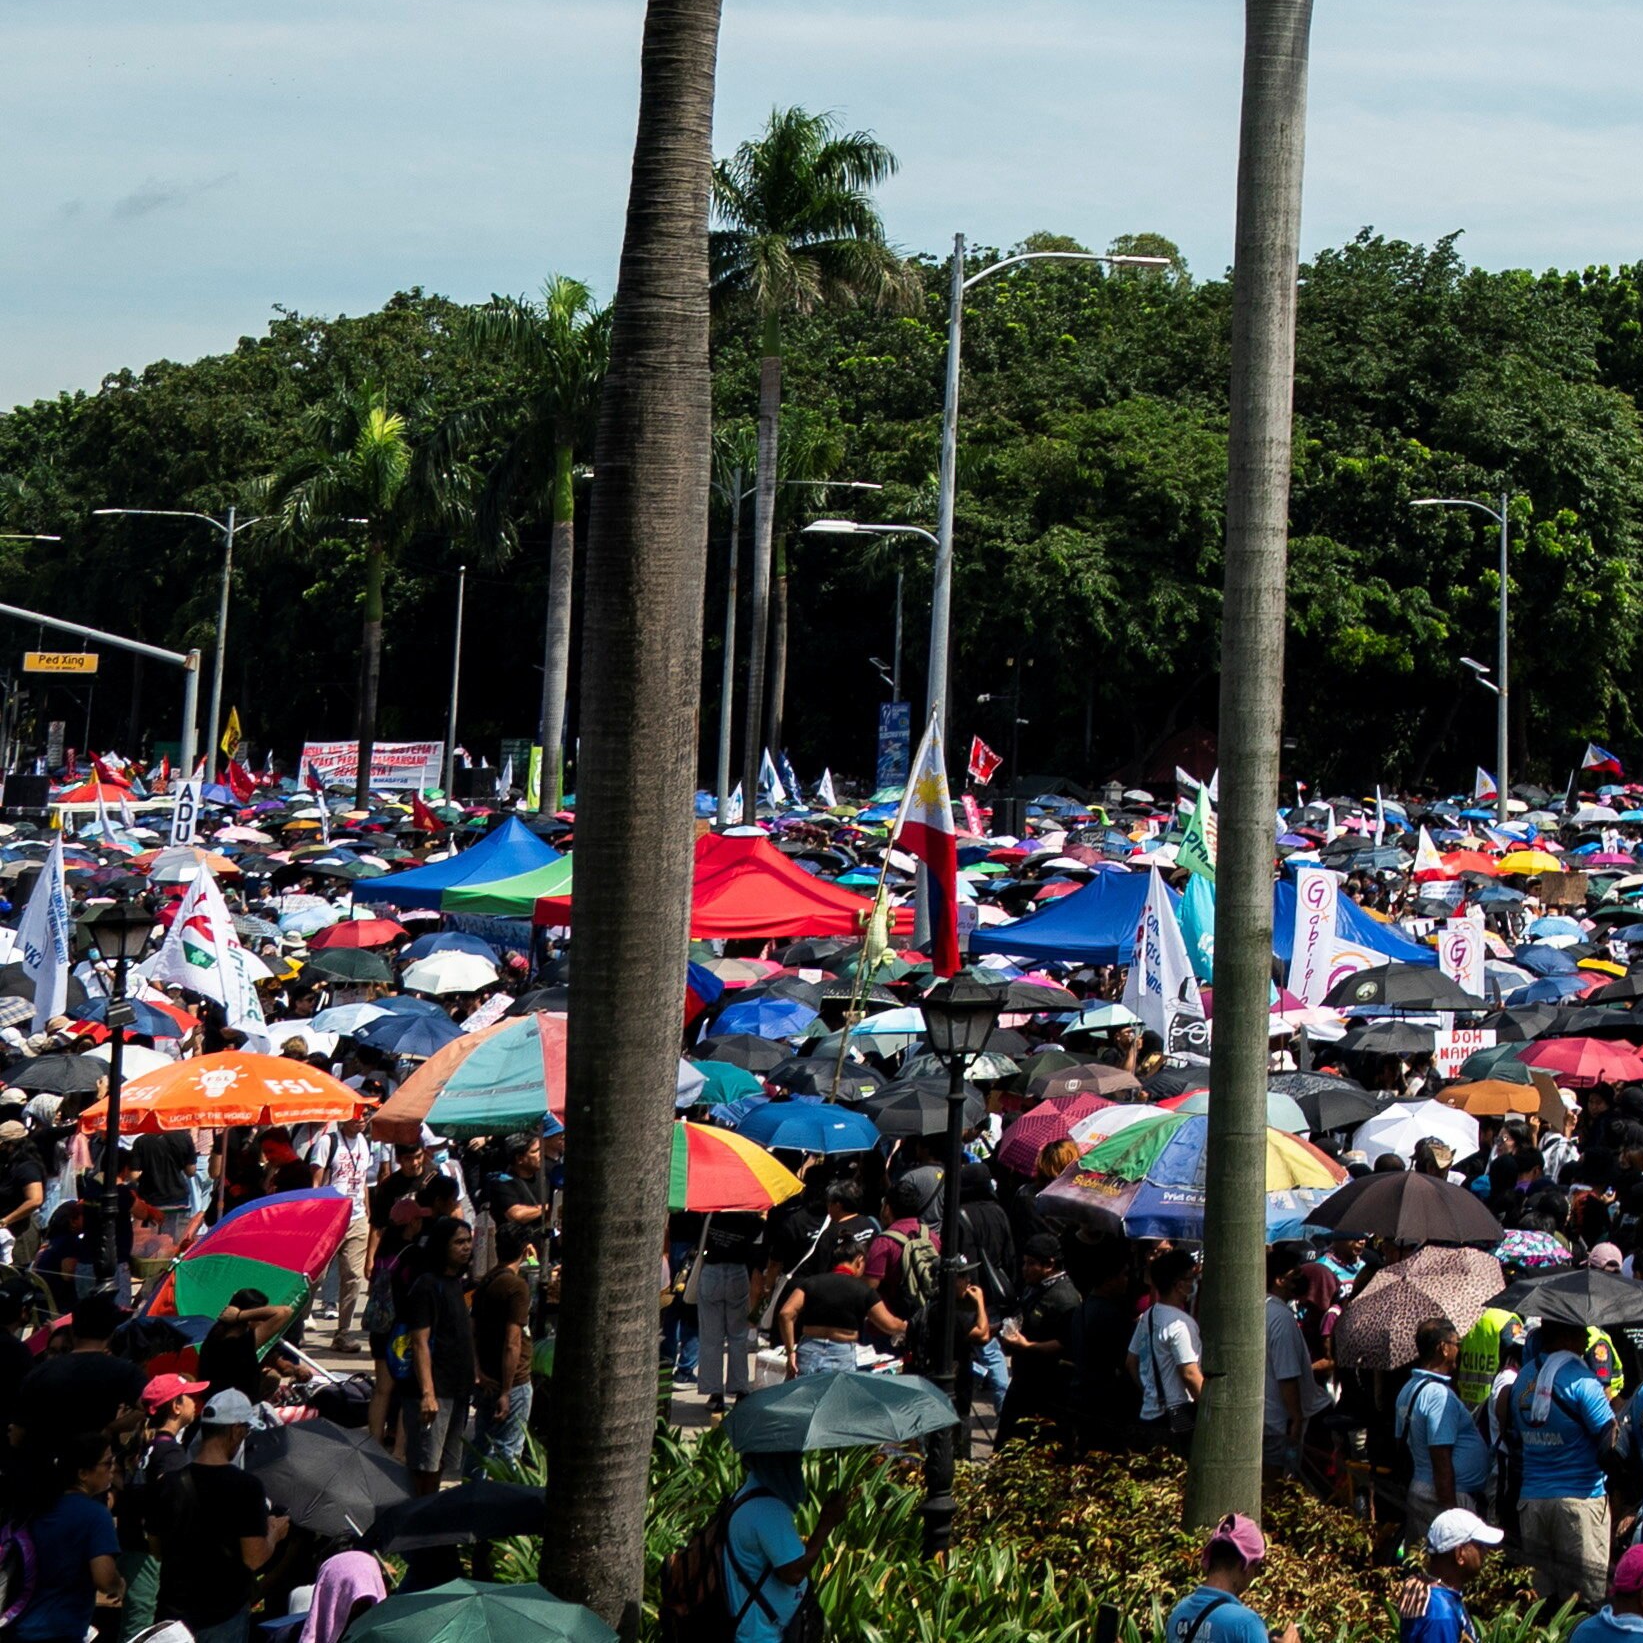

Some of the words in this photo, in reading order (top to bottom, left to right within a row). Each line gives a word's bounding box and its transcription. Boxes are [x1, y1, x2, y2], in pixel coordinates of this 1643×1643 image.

[38, 655, 60, 665] Ped
[61, 656, 85, 667] Xing
[1451, 1030, 1483, 1045] DOH
[264, 1077, 325, 1095] FSL
[1463, 1350, 1496, 1373] OLICE
